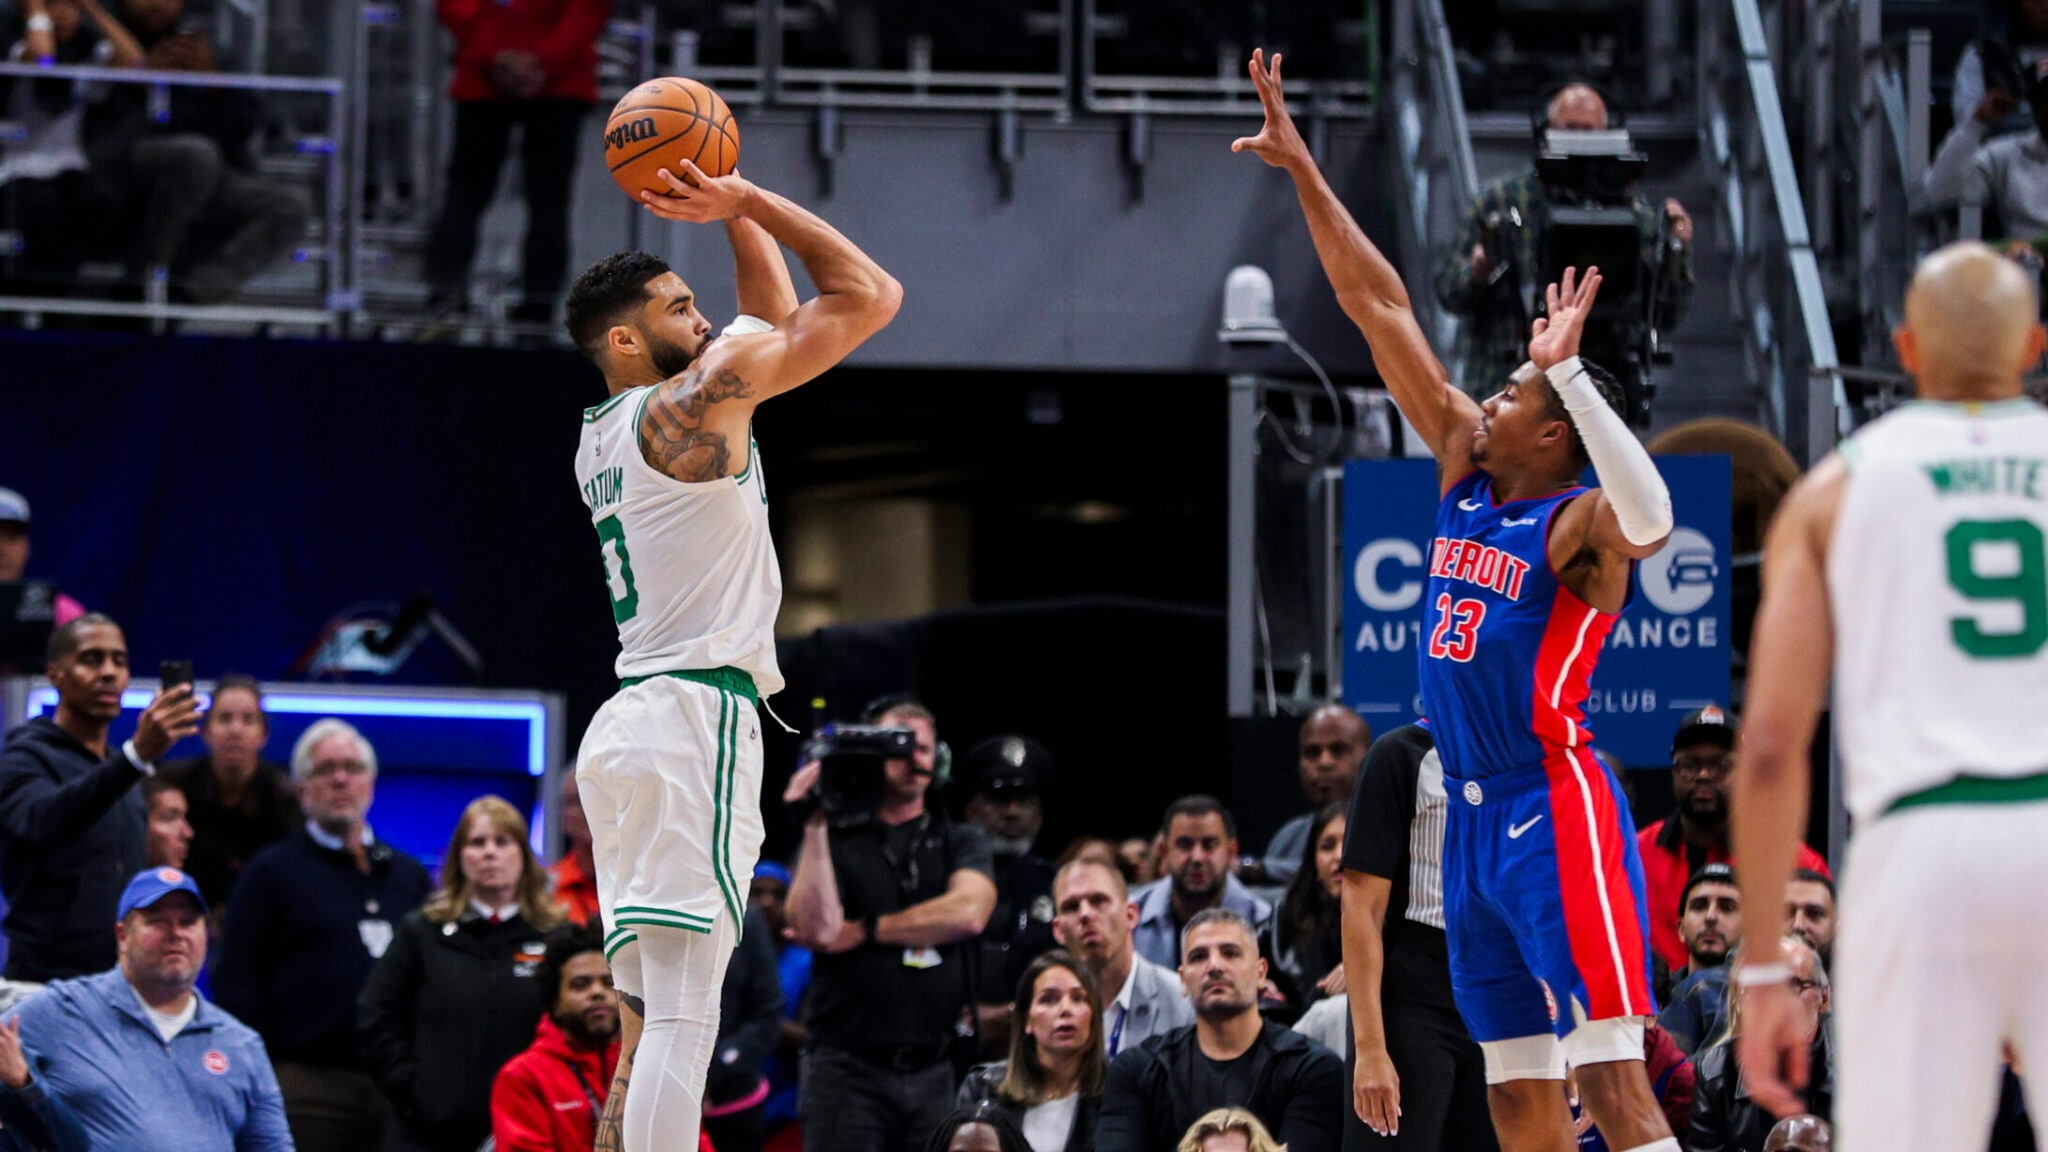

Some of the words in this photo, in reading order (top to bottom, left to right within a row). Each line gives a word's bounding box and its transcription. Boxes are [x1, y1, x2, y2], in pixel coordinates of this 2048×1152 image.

[605, 117, 658, 149] Wilso
[583, 466, 624, 514] TATUM
[1920, 458, 2042, 498] WHITE
[1945, 518, 2048, 660] 9
[1355, 621, 1421, 652] AUT
[1611, 616, 1718, 649] ANCE
[1428, 592, 1487, 663] 23
[1588, 688, 1657, 714] CLUB
